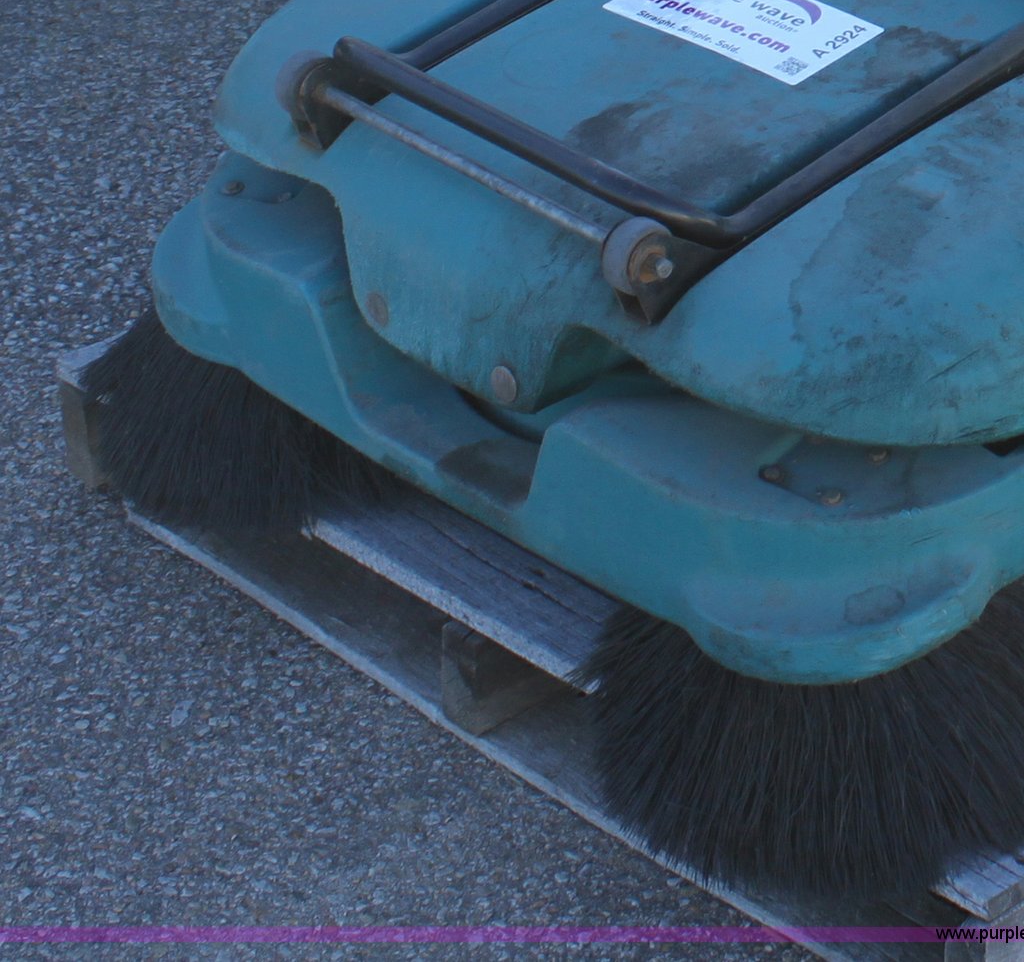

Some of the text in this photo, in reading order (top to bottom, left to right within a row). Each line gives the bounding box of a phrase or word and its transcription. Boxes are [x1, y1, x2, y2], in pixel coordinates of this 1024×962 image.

[750, 0, 806, 27] wave
[812, 24, 867, 59] A 2924
